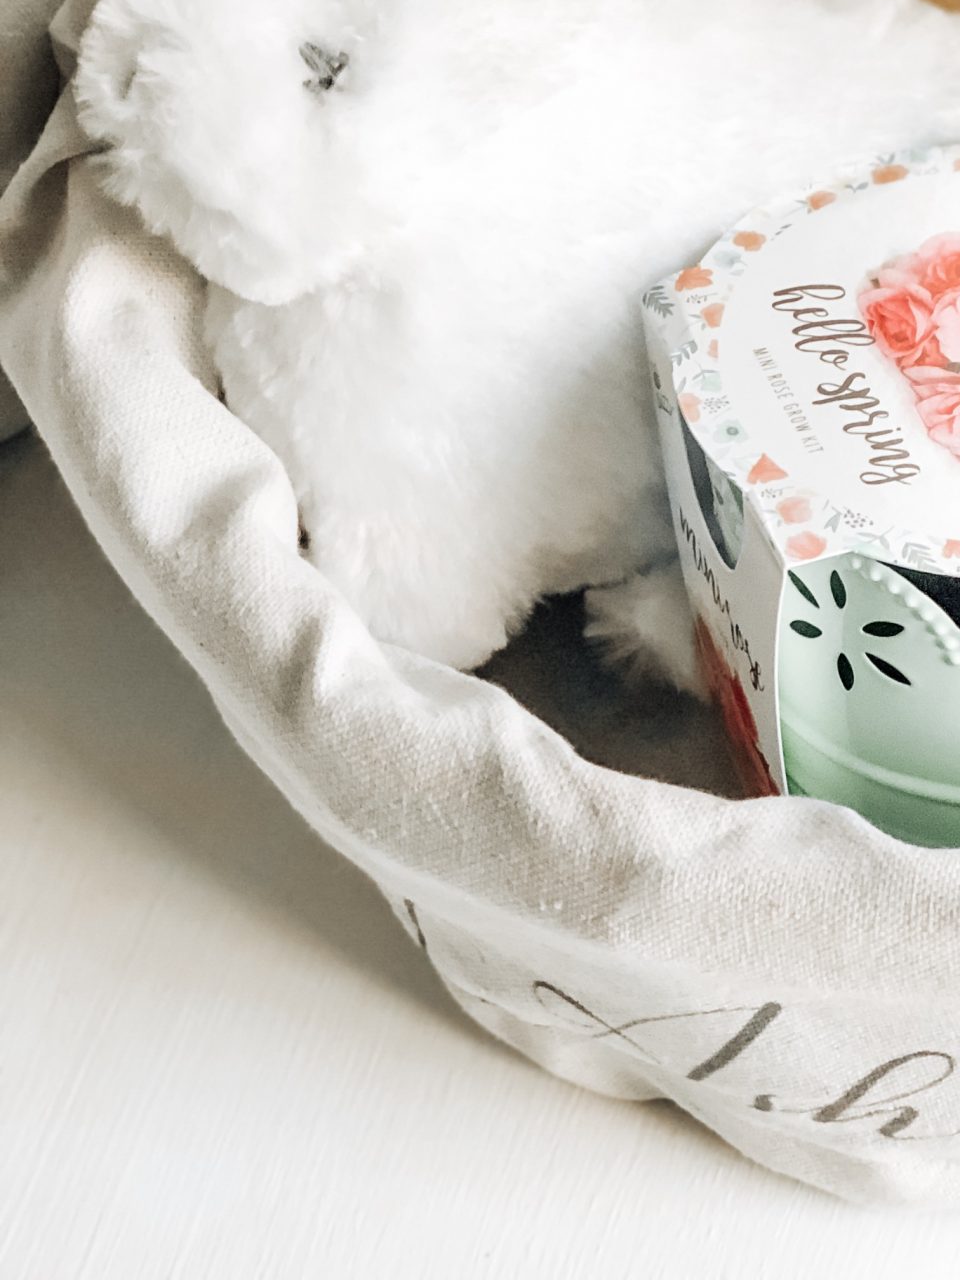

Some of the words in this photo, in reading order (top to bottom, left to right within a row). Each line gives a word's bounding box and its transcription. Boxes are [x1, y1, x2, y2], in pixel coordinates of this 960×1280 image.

[772, 284, 876, 371] hello
[753, 346, 778, 371] MINI
[767, 373, 795, 401] ROSE
[782, 402, 813, 432] GROW
[801, 434, 825, 454] KIT
[812, 372, 921, 485] spring
